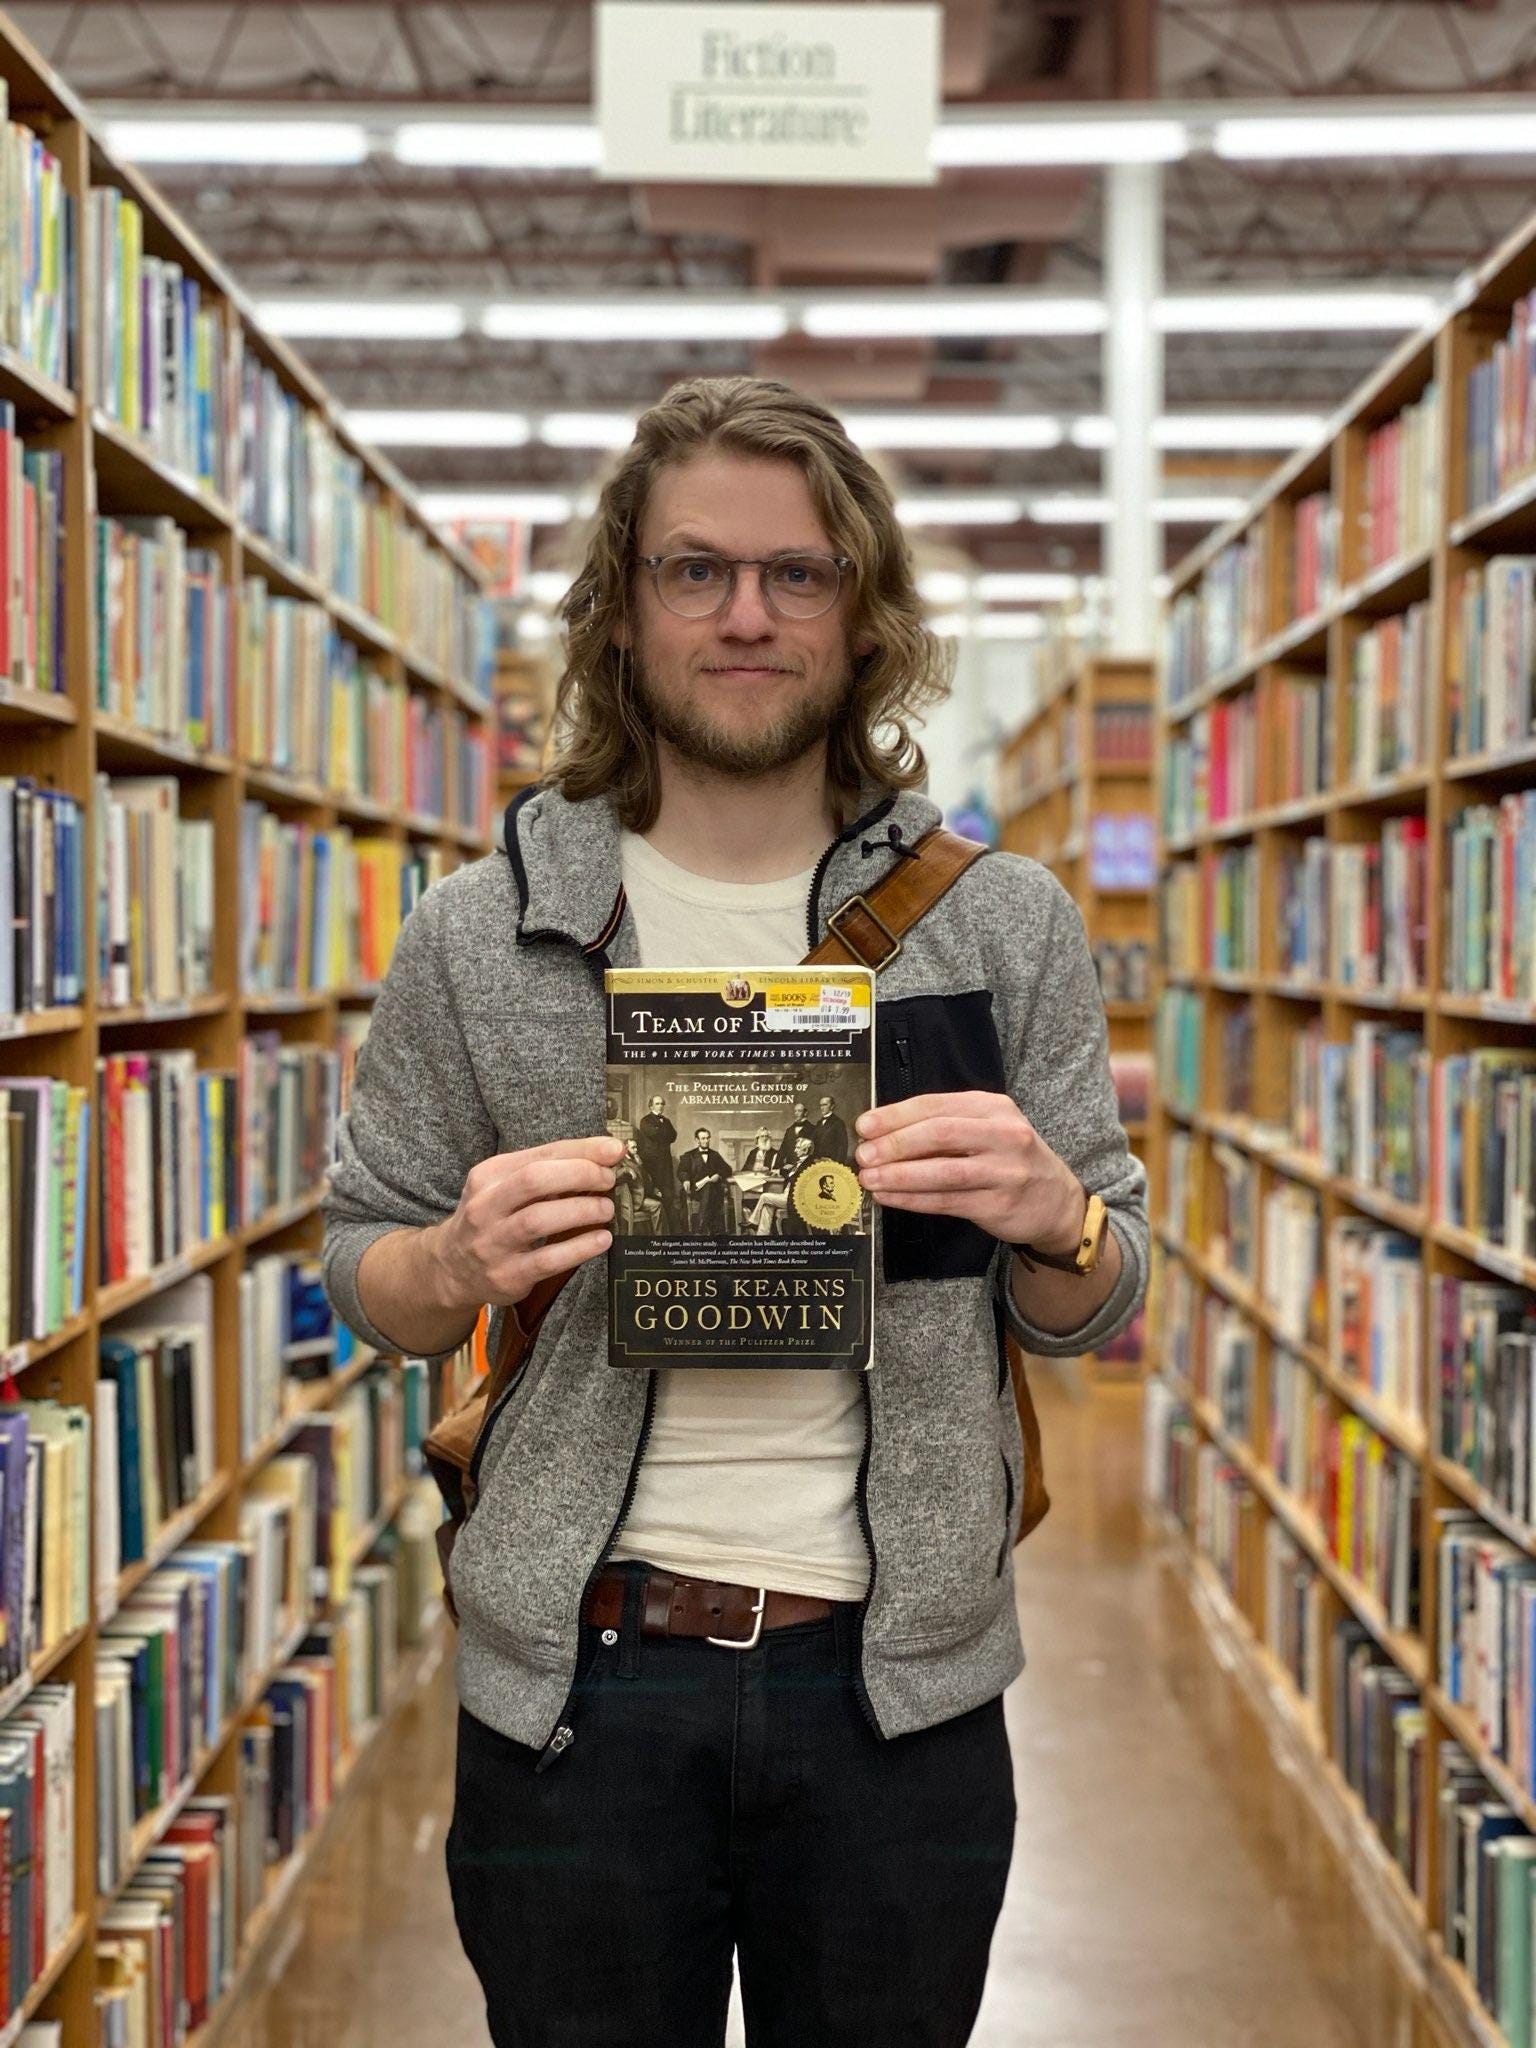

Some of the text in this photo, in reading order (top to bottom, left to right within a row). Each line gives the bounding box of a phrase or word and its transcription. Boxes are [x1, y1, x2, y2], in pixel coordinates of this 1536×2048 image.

[702, 28, 837, 79] Fiction
[668, 92, 870, 146] Literature
[666, 976, 672, 984] &
[675, 976, 719, 984] SCHUSTER
[801, 976, 835, 984] LIBRARY
[781, 993, 807, 1002] BOOKS
[623, 1050, 647, 1058] THE
[673, 1050, 699, 1058] NEW
[704, 1050, 734, 1058] YORK
[740, 1050, 776, 1058] TIMES
[780, 1049, 852, 1057] BESTSELLER
[680, 1095, 795, 1105] ABRAHAM LINCOLN
[764, 1240, 789, 1248] brilliantly
[692, 1249, 717, 1257] preserved
[634, 1278, 846, 1298] DORIS KEARNS
[634, 1304, 845, 1331] GOODWIN
